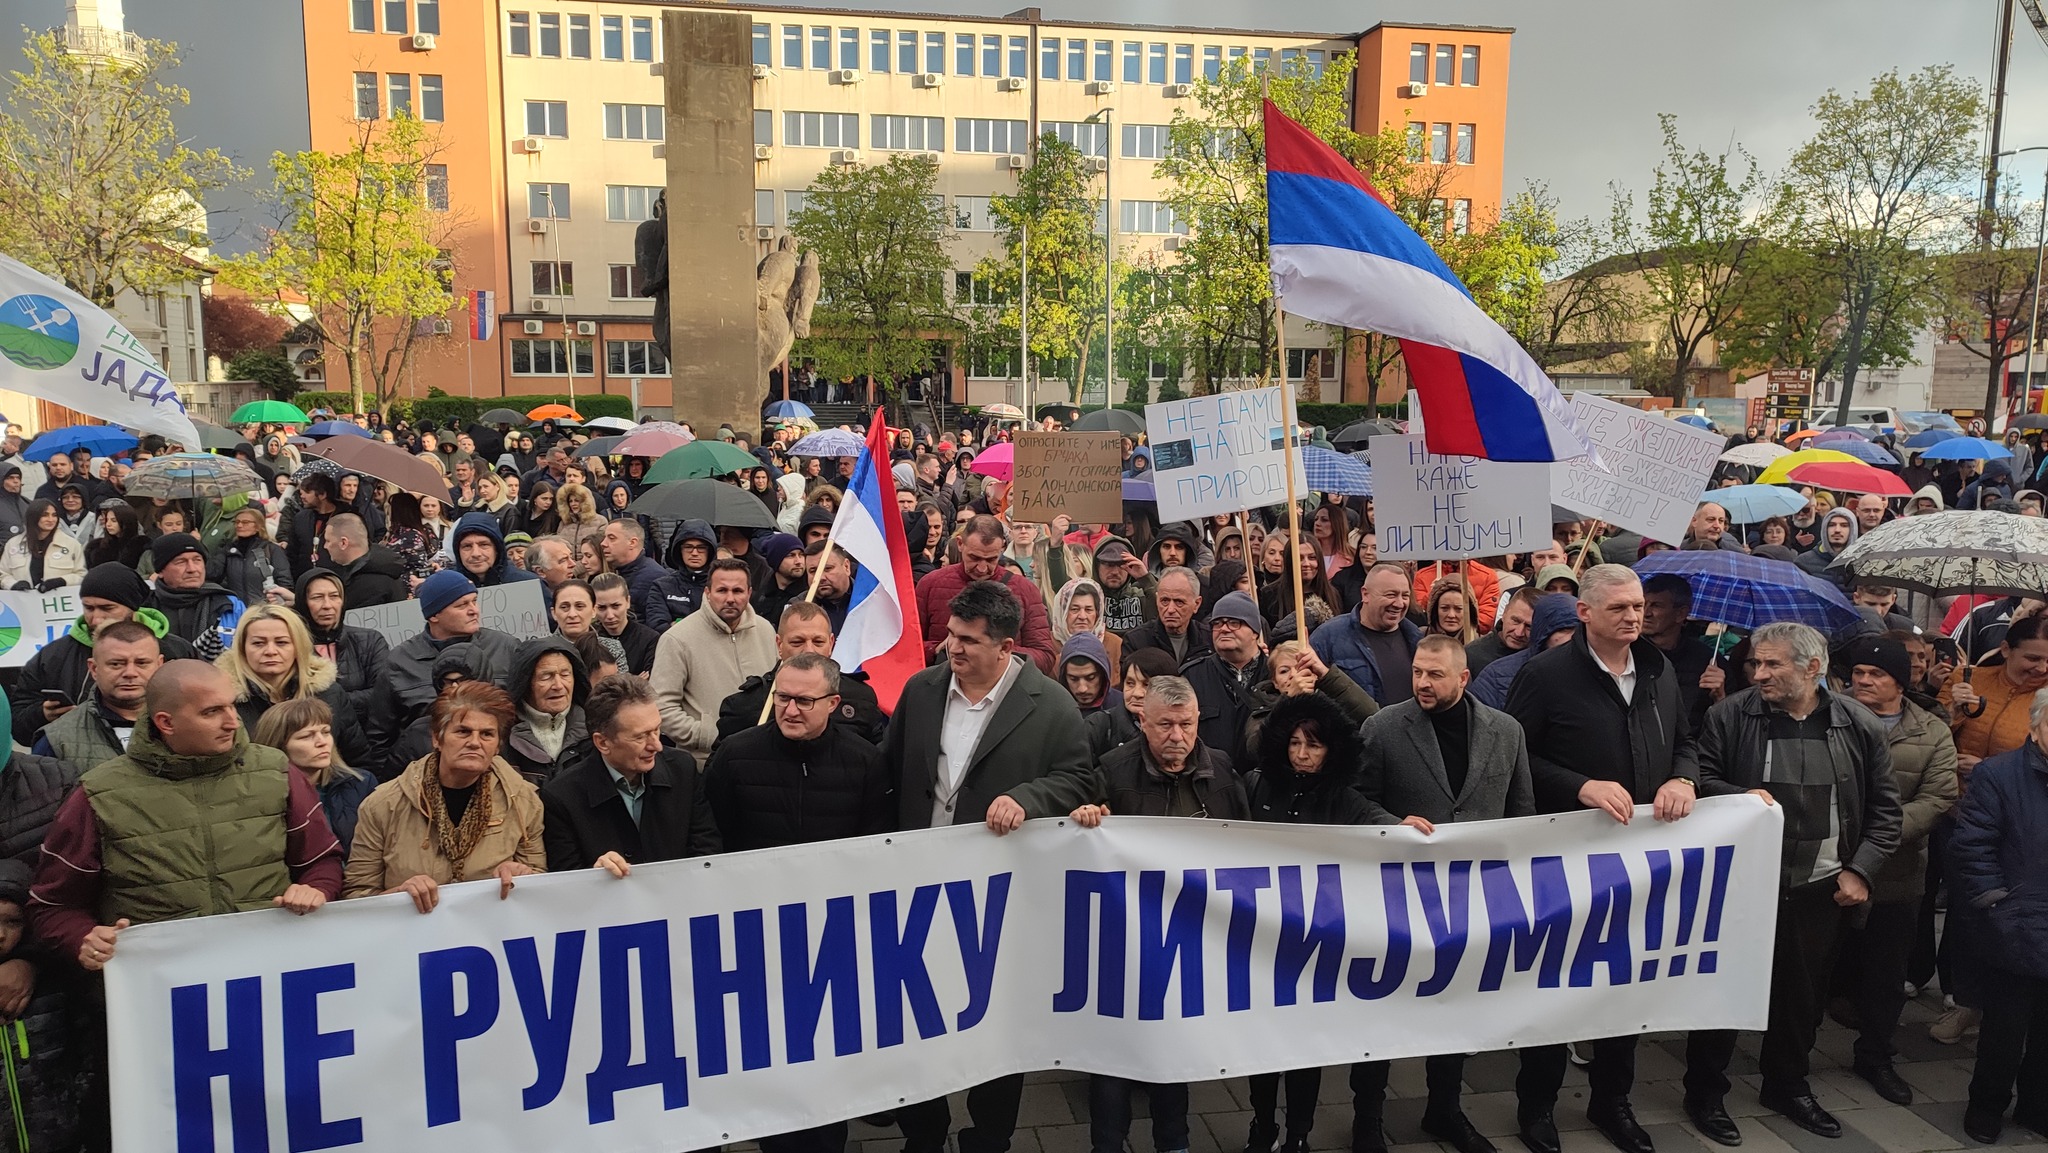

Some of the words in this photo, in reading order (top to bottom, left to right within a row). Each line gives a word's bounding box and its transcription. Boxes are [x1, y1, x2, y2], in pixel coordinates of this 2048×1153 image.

[81, 351, 186, 415] ЈАДА
[1166, 400, 1206, 435] НЕ
[1217, 388, 1283, 427] ДАМО
[1018, 437, 1079, 448] ОПРОСТИТЕ
[1087, 439, 1094, 449] У
[1101, 438, 1121, 450] ИМЕ
[1044, 449, 1089, 464] БРЧАКА
[1192, 423, 1267, 462] НАШУ
[1615, 415, 1724, 477] ЖЕЛИМО
[1016, 465, 1050, 478] ЗБОГ
[1040, 479, 1122, 494] ЛОНДОНСКОГА
[1416, 463, 1479, 492] КАЖЕ
[1021, 490, 1065, 510] ЂАКА
[1433, 492, 1469, 524] НЕ
[1380, 516, 1523, 553] ЛИТИЈУМУ!
[42, 595, 74, 614] НЕ
[171, 962, 364, 1153] НЕ
[419, 871, 1012, 1128] РУДНИКУ
[1053, 844, 1735, 1021] ЛИТИЈУМА!!!
